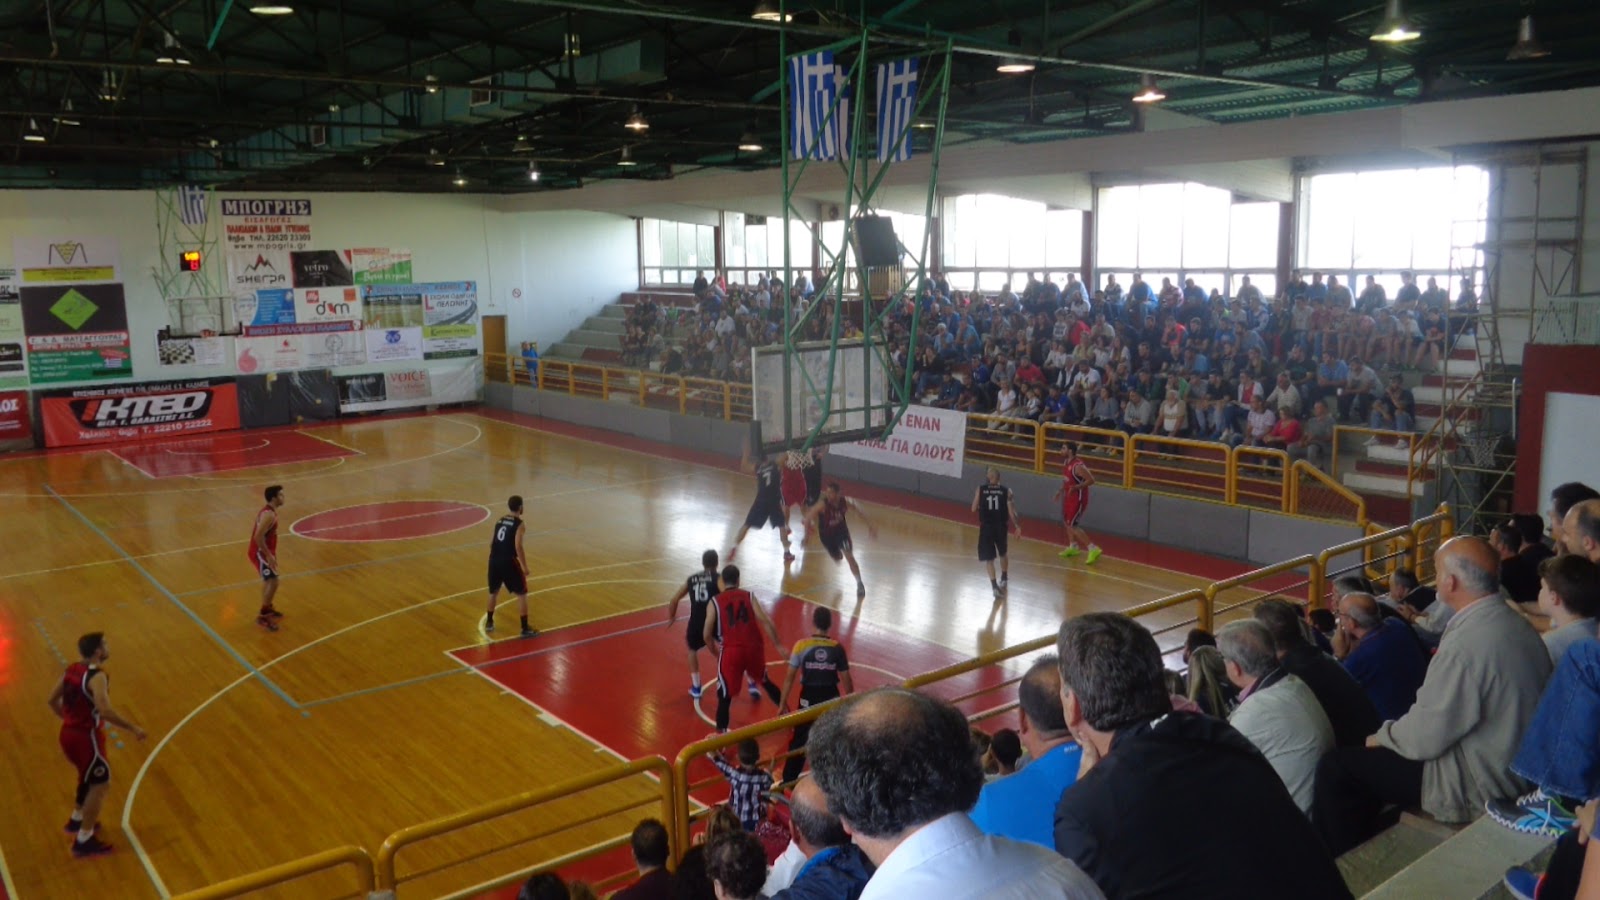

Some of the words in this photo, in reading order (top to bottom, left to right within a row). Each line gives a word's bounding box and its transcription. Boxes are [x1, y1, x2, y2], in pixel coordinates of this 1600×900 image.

[226, 200, 309, 215] ΜΠΟΓΡΗΣ
[390, 371, 427, 383] VOICE
[154, 423, 183, 433] 22210
[906, 414, 941, 432] ΕΝΑΝ
[890, 438, 909, 455] ΓΙΑ
[912, 442, 956, 462] ΟΛΟΥΣ
[986, 495, 999, 510] 11
[497, 526, 507, 541] 6
[726, 601, 750, 628] 14
